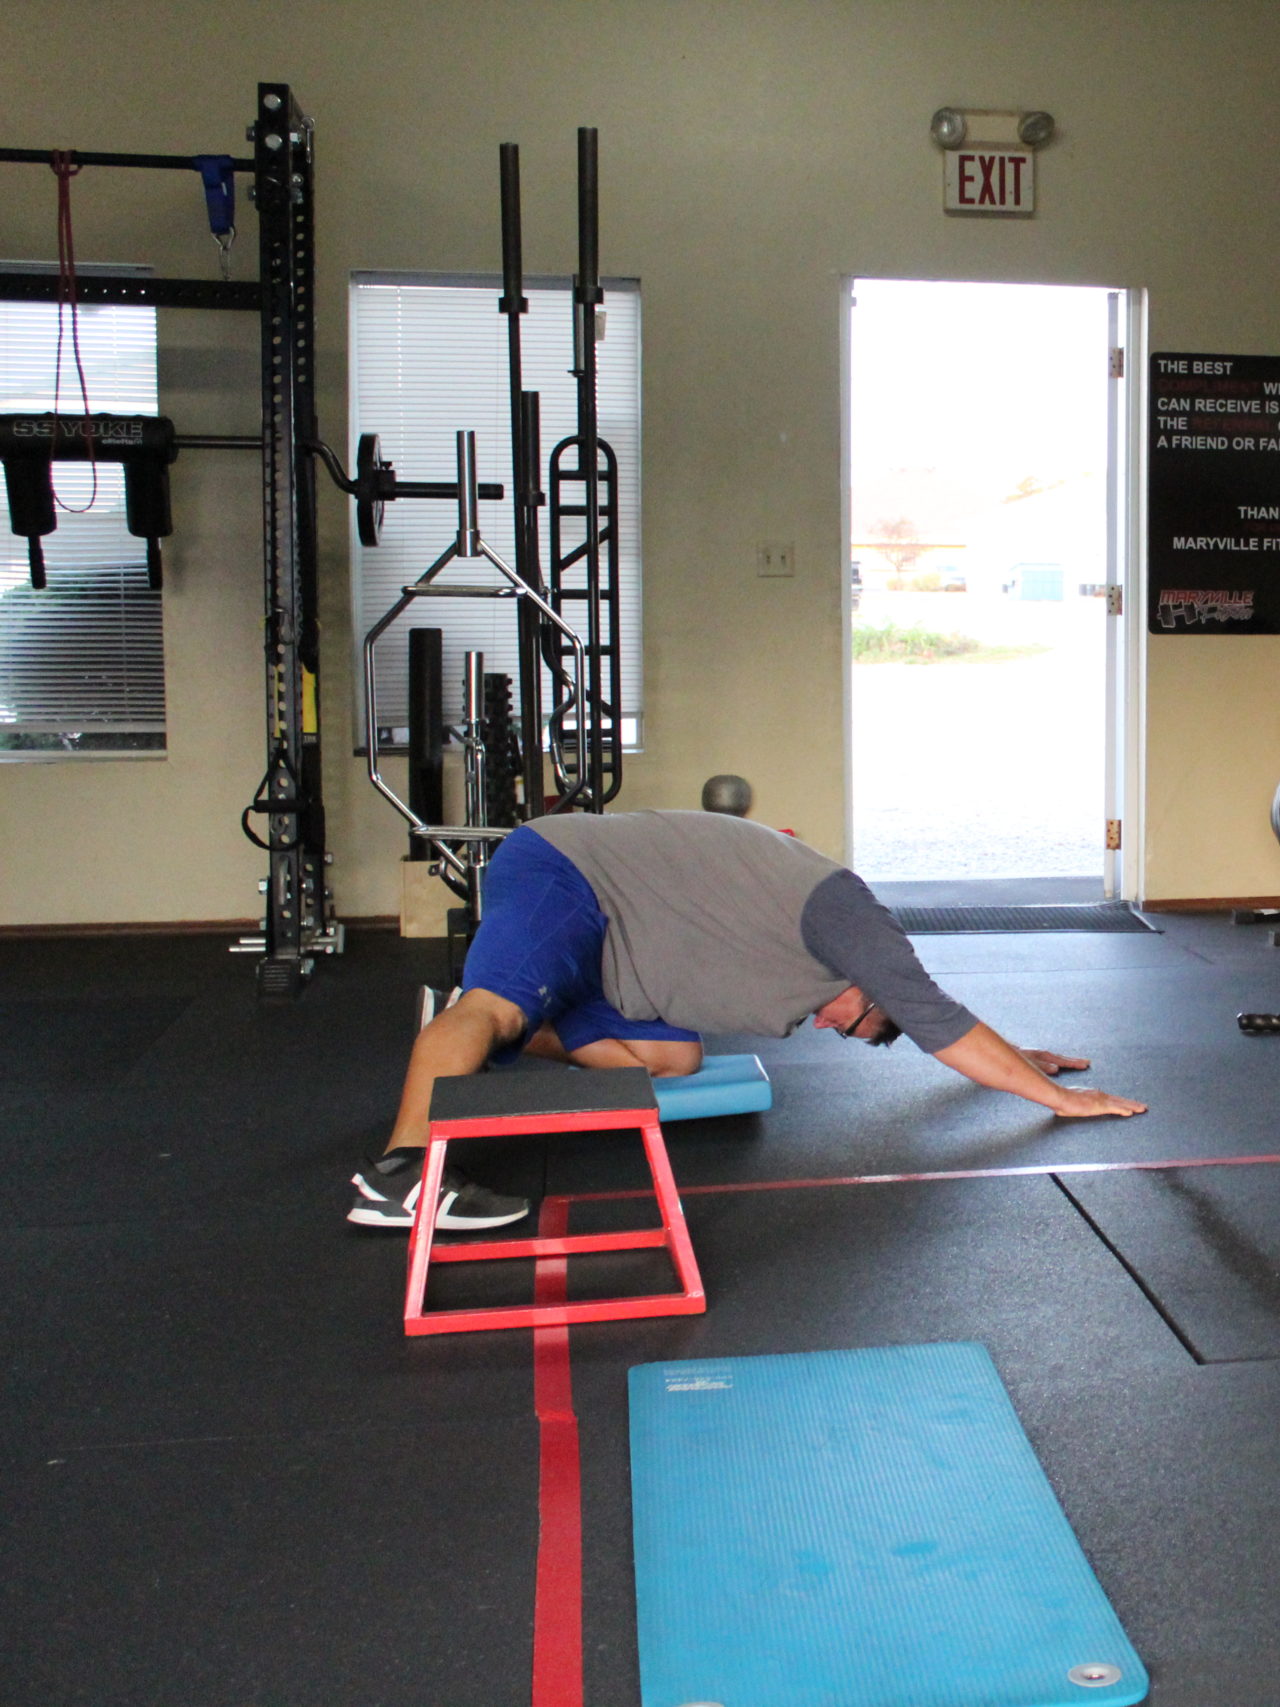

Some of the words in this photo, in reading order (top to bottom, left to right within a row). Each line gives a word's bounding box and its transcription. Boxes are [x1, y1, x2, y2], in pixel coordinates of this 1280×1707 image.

[958, 154, 1027, 206] EXIT
[1158, 360, 1188, 373] THE
[1193, 361, 1233, 375] BEST
[1157, 398, 1191, 412] CAN
[1195, 399, 1261, 414] RECEIVE
[1266, 401, 1279, 414] IS
[13, 420, 56, 437] SS
[59, 421, 143, 438] YOKE
[1158, 416, 1188, 430] THE
[1157, 436, 1168, 449] A
[1172, 436, 1228, 450] FRIEND
[1232, 437, 1255, 451] OR
[1172, 537, 1258, 551] MARYVILLE
[1160, 590, 1254, 606] MARYVILLE
